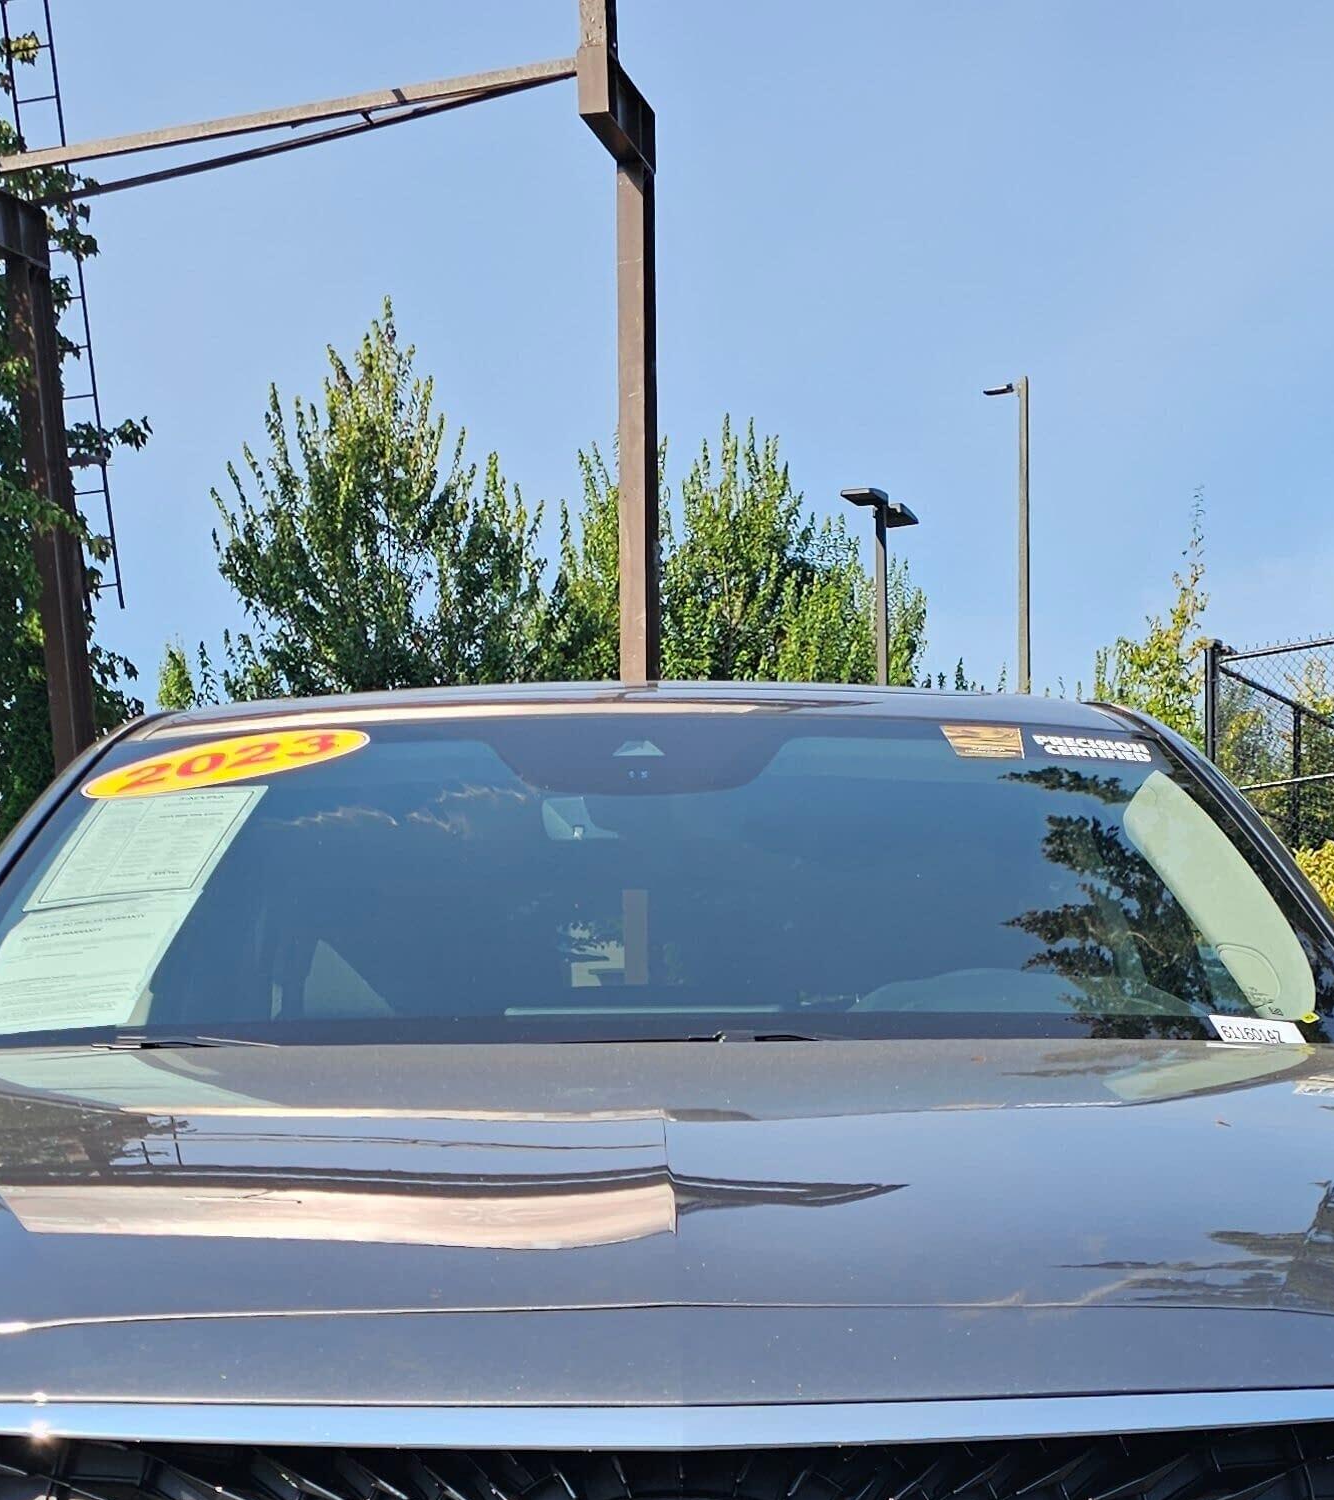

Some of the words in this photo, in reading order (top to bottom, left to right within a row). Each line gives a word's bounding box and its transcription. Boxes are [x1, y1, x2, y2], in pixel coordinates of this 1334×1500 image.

[1032, 734, 1151, 754] PRECISION
[1044, 744, 1153, 763] CERTIFIED
[117, 734, 339, 793] 2023
